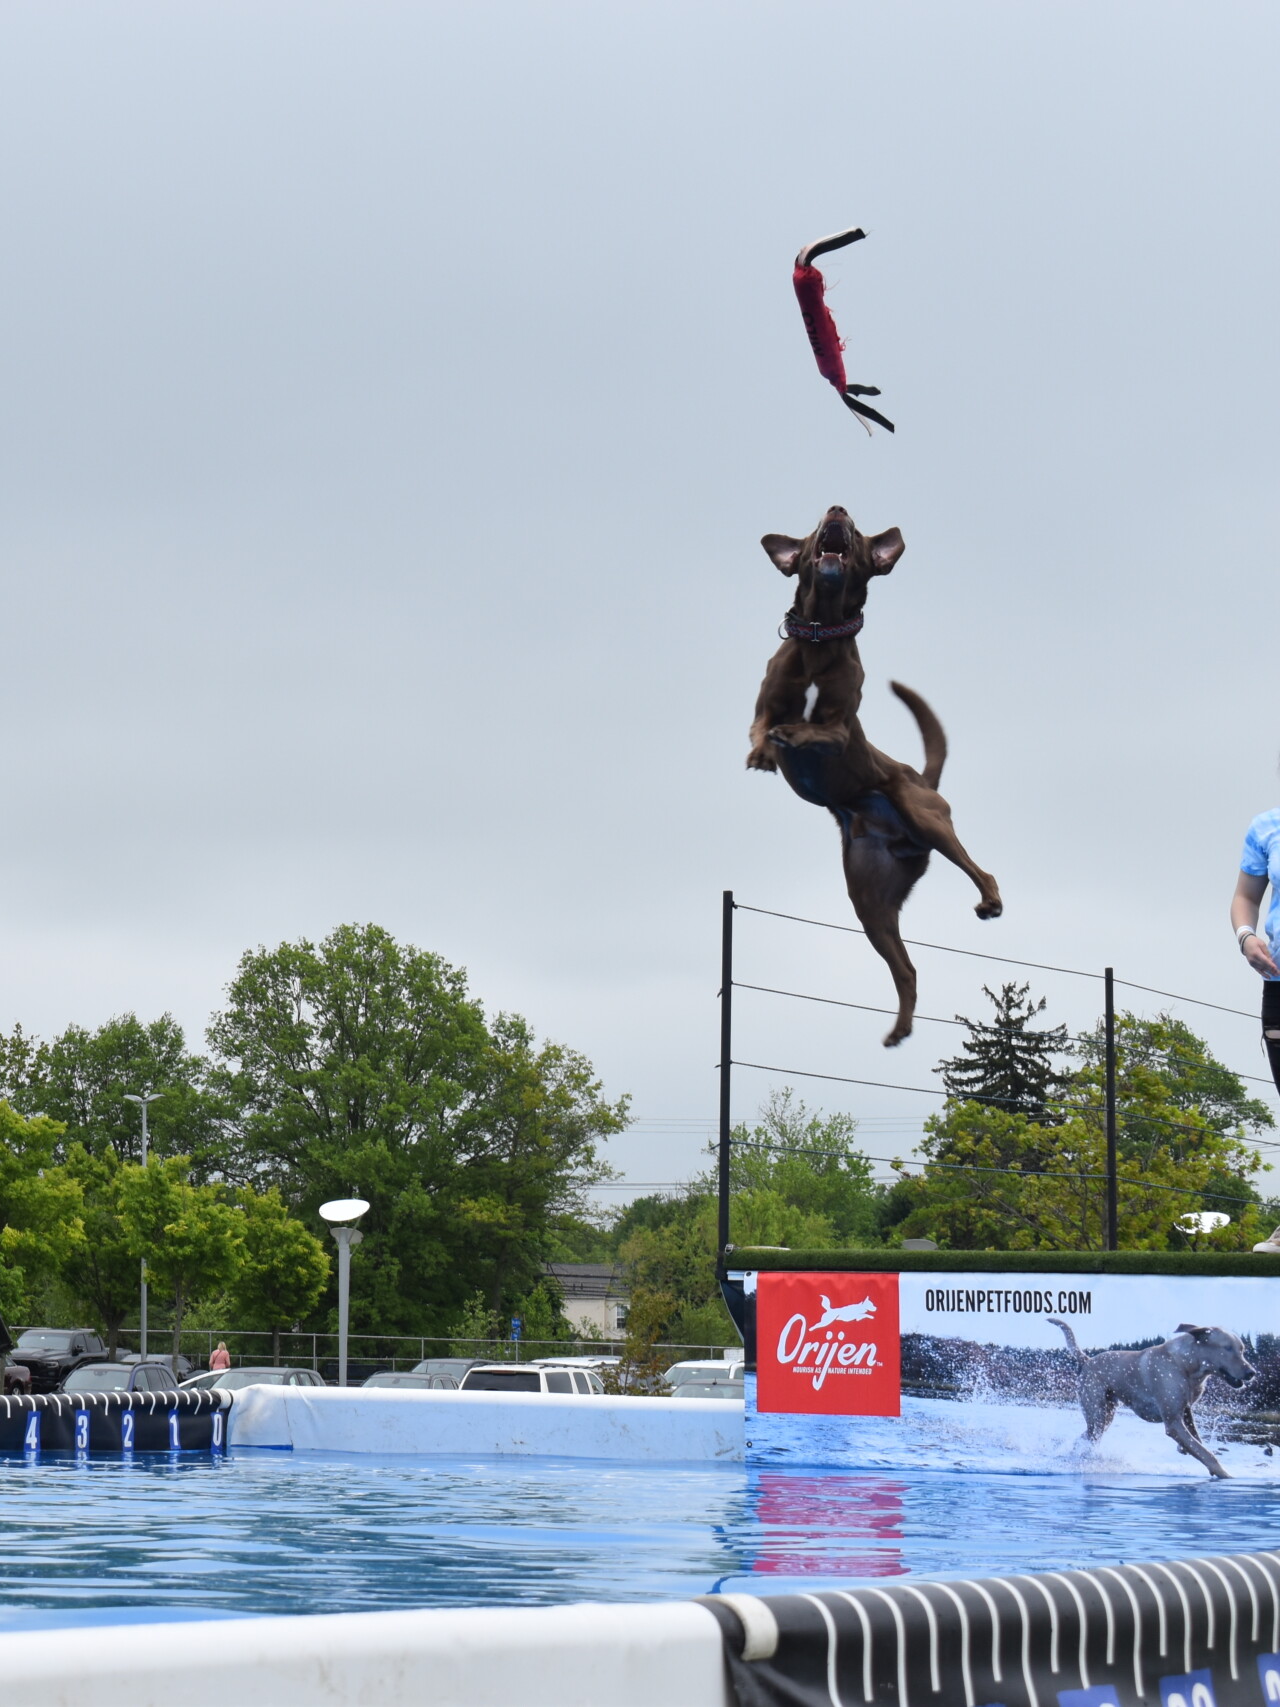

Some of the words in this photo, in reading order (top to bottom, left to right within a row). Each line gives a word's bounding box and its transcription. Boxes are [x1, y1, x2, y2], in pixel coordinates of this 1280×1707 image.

[925, 1289, 1091, 1314] ORIJENPETFOODS.COM
[777, 1313, 877, 1391] Orijen
[848, 1367, 872, 1375] INTENDED
[25, 1416, 37, 1449] 4
[77, 1415, 88, 1448] 3
[123, 1414, 133, 1447] 2
[169, 1414, 179, 1446] 1
[213, 1414, 222, 1446] 0
